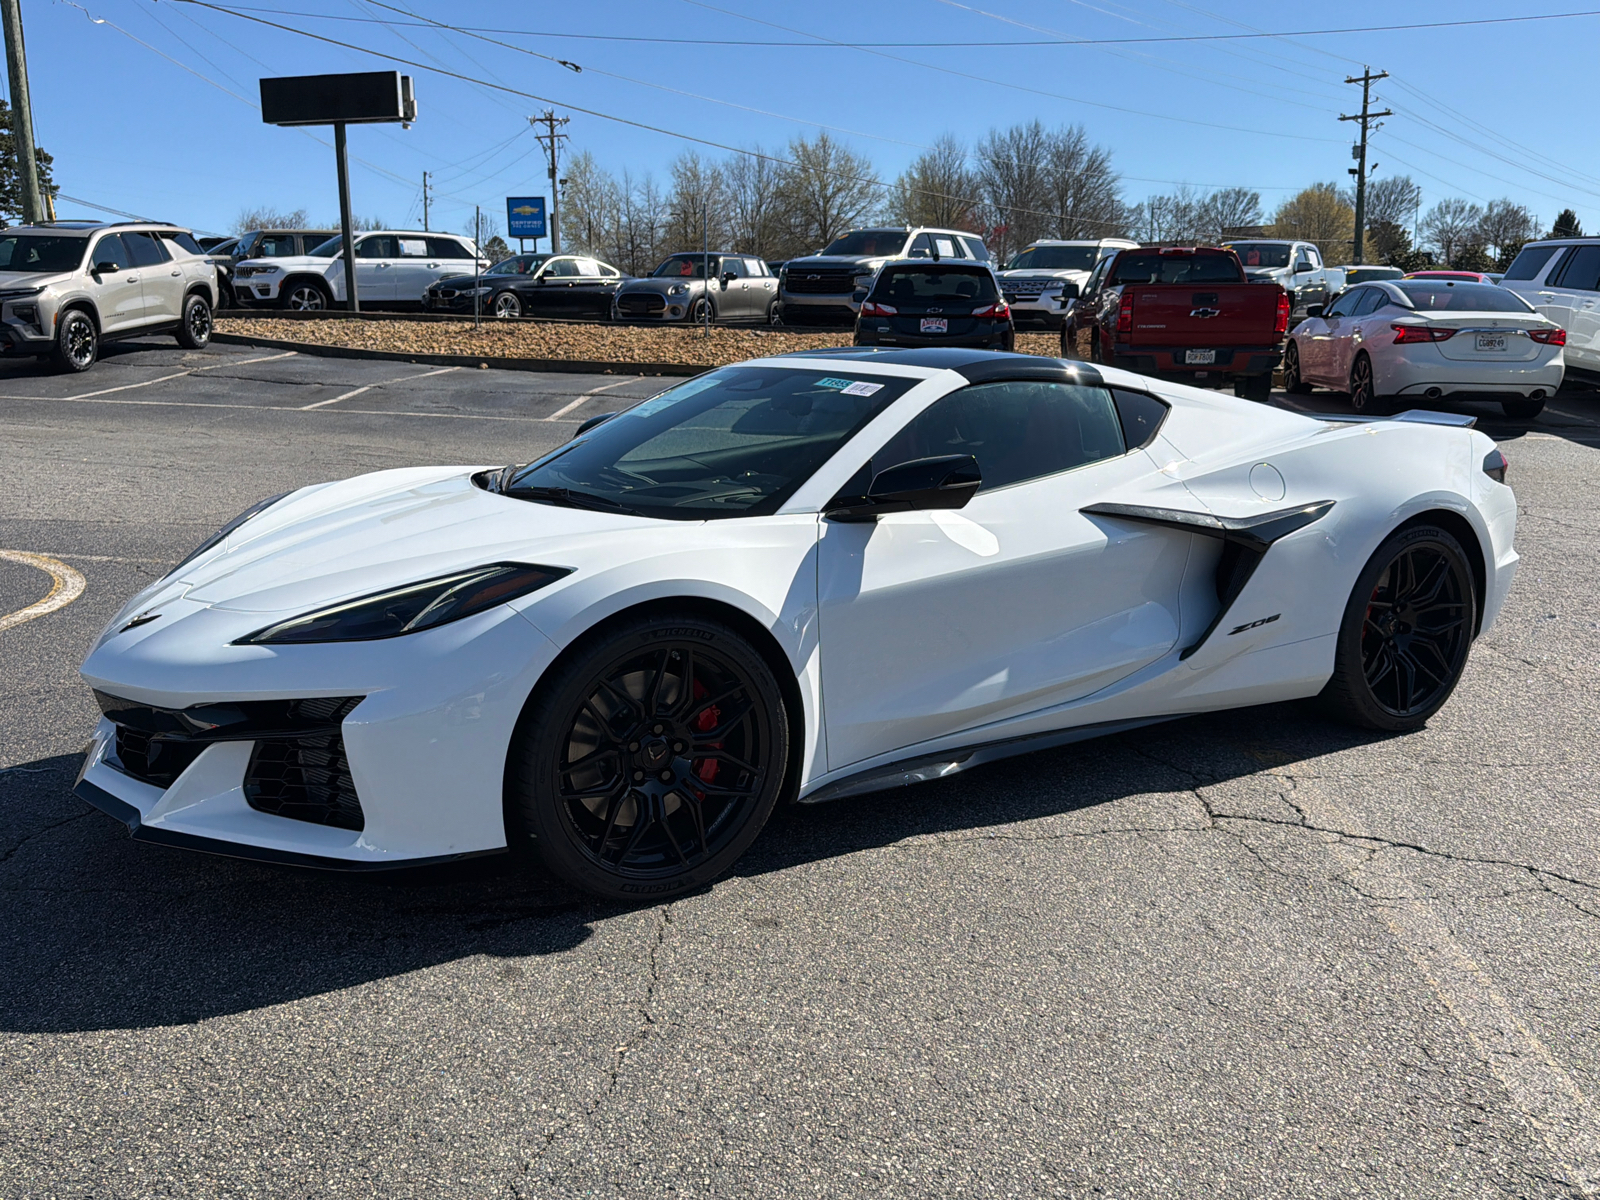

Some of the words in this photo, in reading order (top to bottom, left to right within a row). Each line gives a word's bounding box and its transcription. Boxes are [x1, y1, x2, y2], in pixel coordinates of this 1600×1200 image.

[1227, 613, 1281, 636] Z06
[656, 628, 712, 640] MICHELIN
[708, 802, 732, 833] FORGED
[622, 881, 679, 893] MICHELIN
